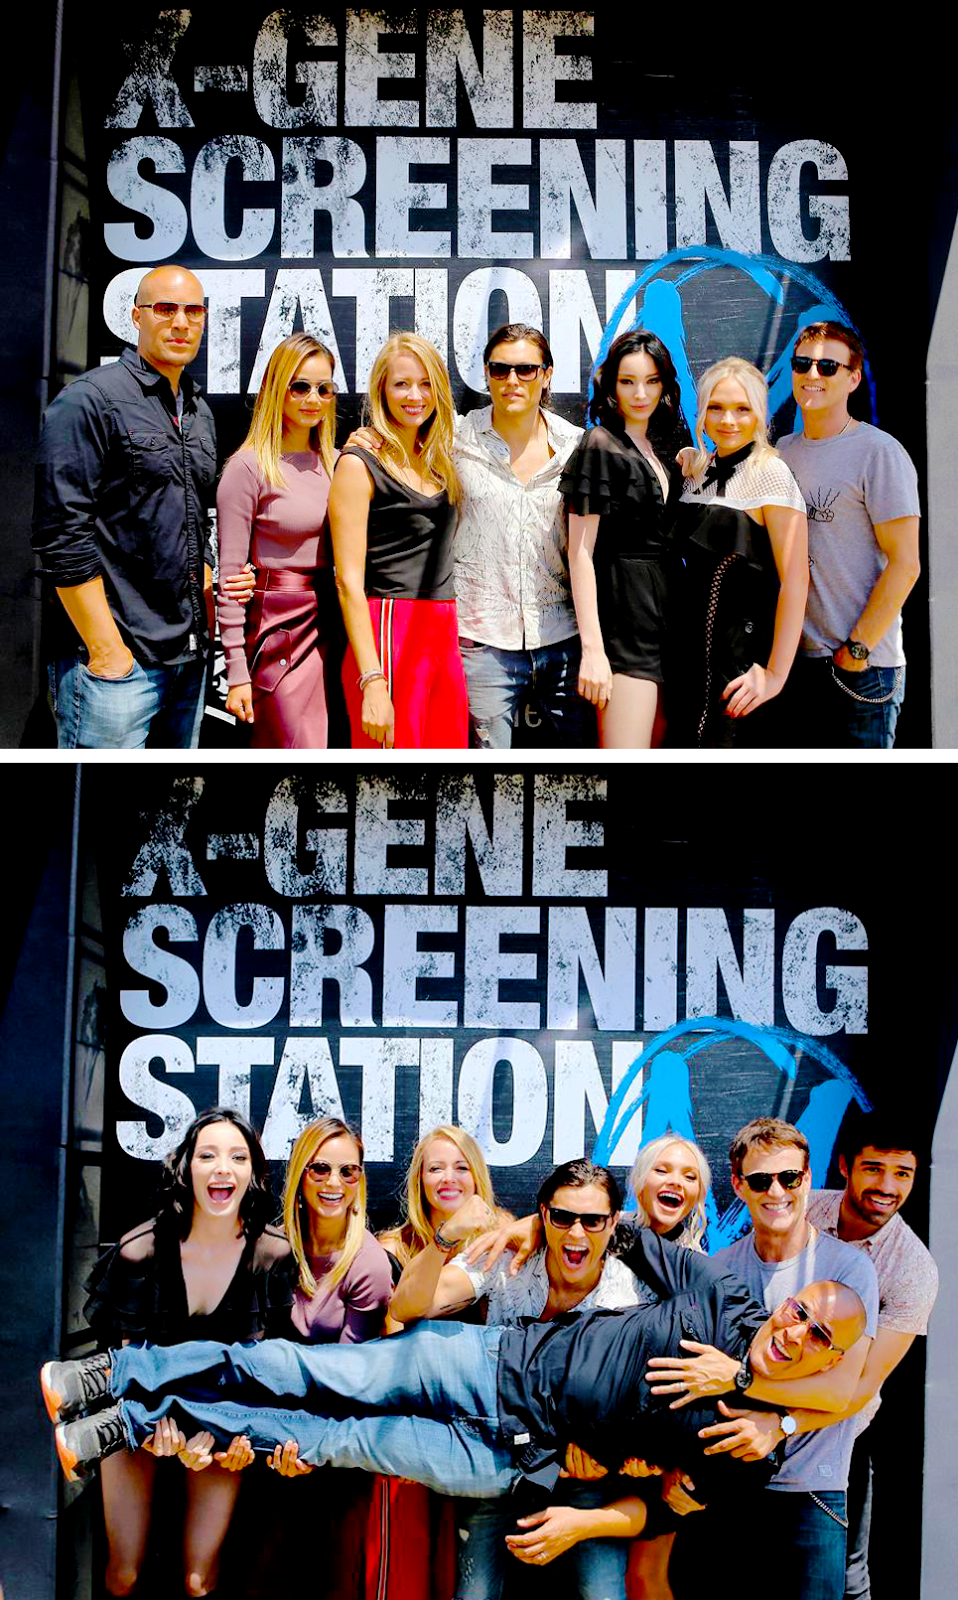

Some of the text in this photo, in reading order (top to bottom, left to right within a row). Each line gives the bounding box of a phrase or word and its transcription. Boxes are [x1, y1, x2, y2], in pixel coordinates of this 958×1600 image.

[104, 9, 597, 128] X-GENE
[104, 136, 851, 262] SCREENING
[121, 773, 608, 896] X-GENE
[120, 903, 869, 1035] SCREENING
[116, 1035, 644, 1167] STATION
